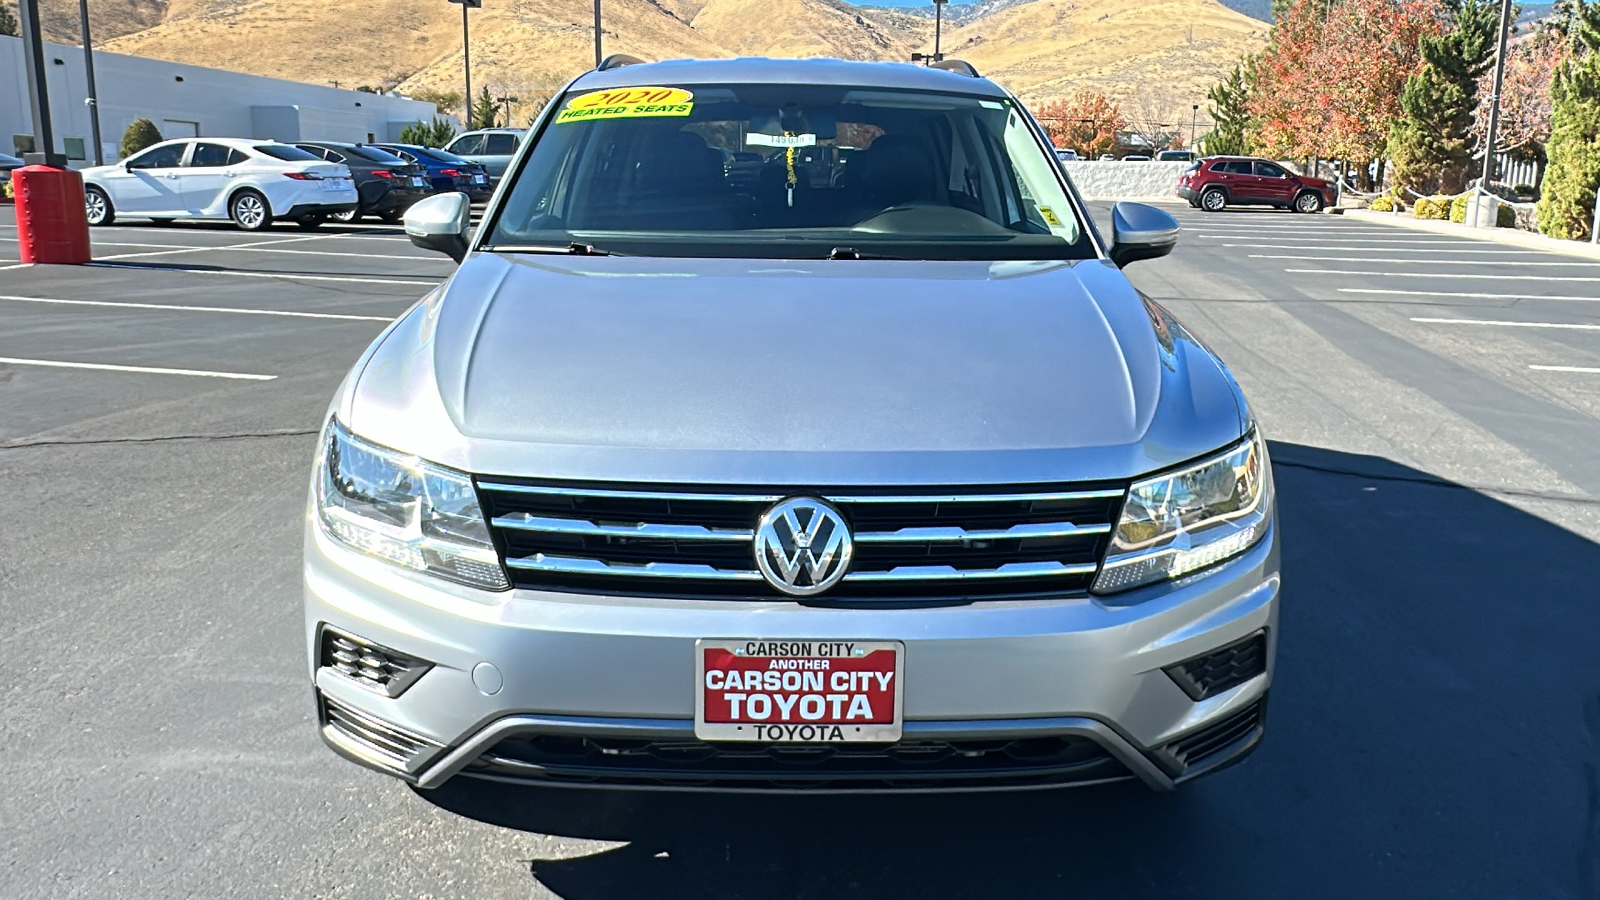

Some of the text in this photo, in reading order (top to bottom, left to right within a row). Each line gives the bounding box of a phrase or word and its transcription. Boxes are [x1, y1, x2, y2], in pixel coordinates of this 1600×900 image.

[584, 90, 672, 107] 2020
[561, 105, 688, 119] HEATED SEATS
[746, 642, 855, 656] CARSON CITY
[769, 660, 830, 669] ANOTHER
[706, 671, 894, 691] CARSON CITY
[724, 694, 873, 720] TOYOTA
[754, 725, 844, 740] TOYOTA
